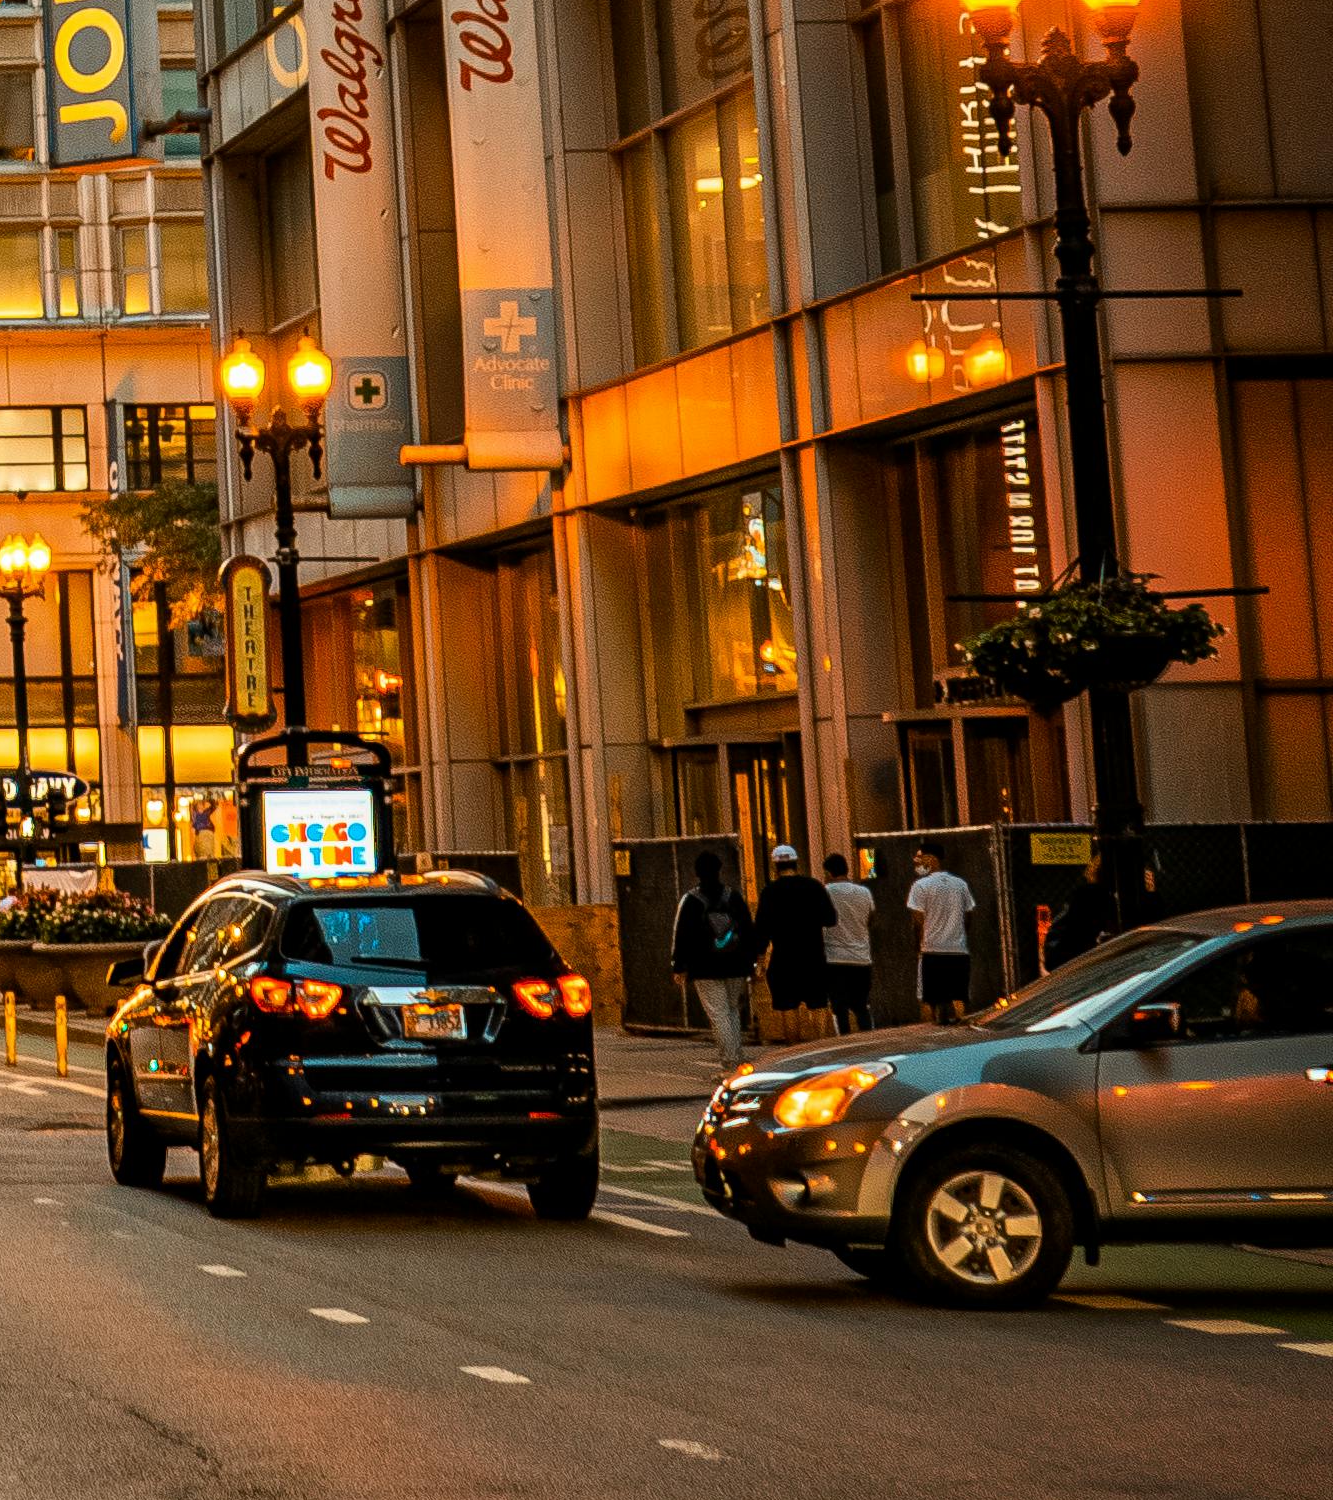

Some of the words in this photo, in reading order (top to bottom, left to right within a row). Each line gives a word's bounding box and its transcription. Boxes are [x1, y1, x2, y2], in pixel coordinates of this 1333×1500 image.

[474, 357, 550, 372] Advocate
[491, 374, 534, 390] Clinic
[244, 587, 258, 709] THEATRE
[270, 823, 367, 843] CHICAGO
[277, 848, 301, 867] IN
[310, 846, 366, 866] TUNE
